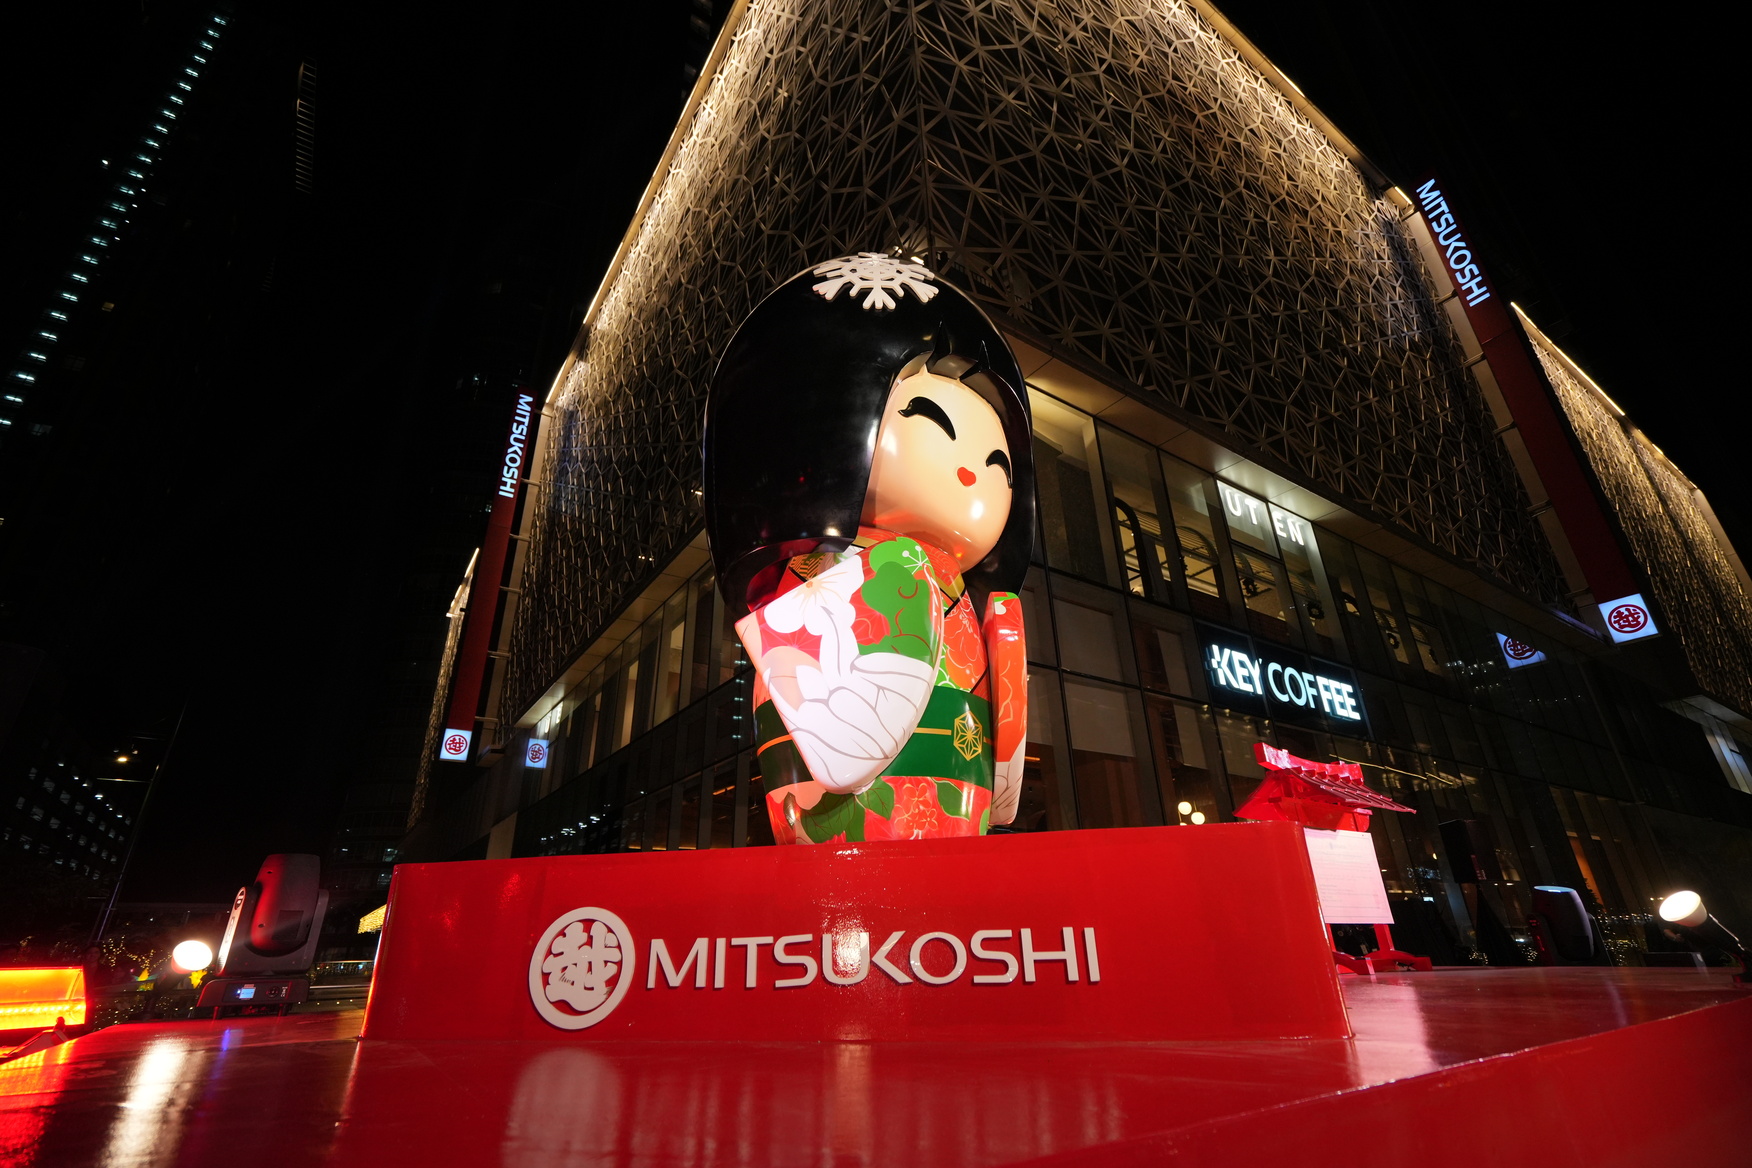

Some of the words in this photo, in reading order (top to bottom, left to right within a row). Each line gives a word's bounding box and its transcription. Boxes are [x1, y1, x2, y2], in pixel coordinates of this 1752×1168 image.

[1416, 178, 1491, 307] MITSUKOSHI
[498, 393, 534, 498] MITSUKOSHI
[1211, 643, 1263, 695] KEY
[1267, 661, 1361, 721] COFFEE
[646, 927, 1100, 988] MITSUKOSHI
